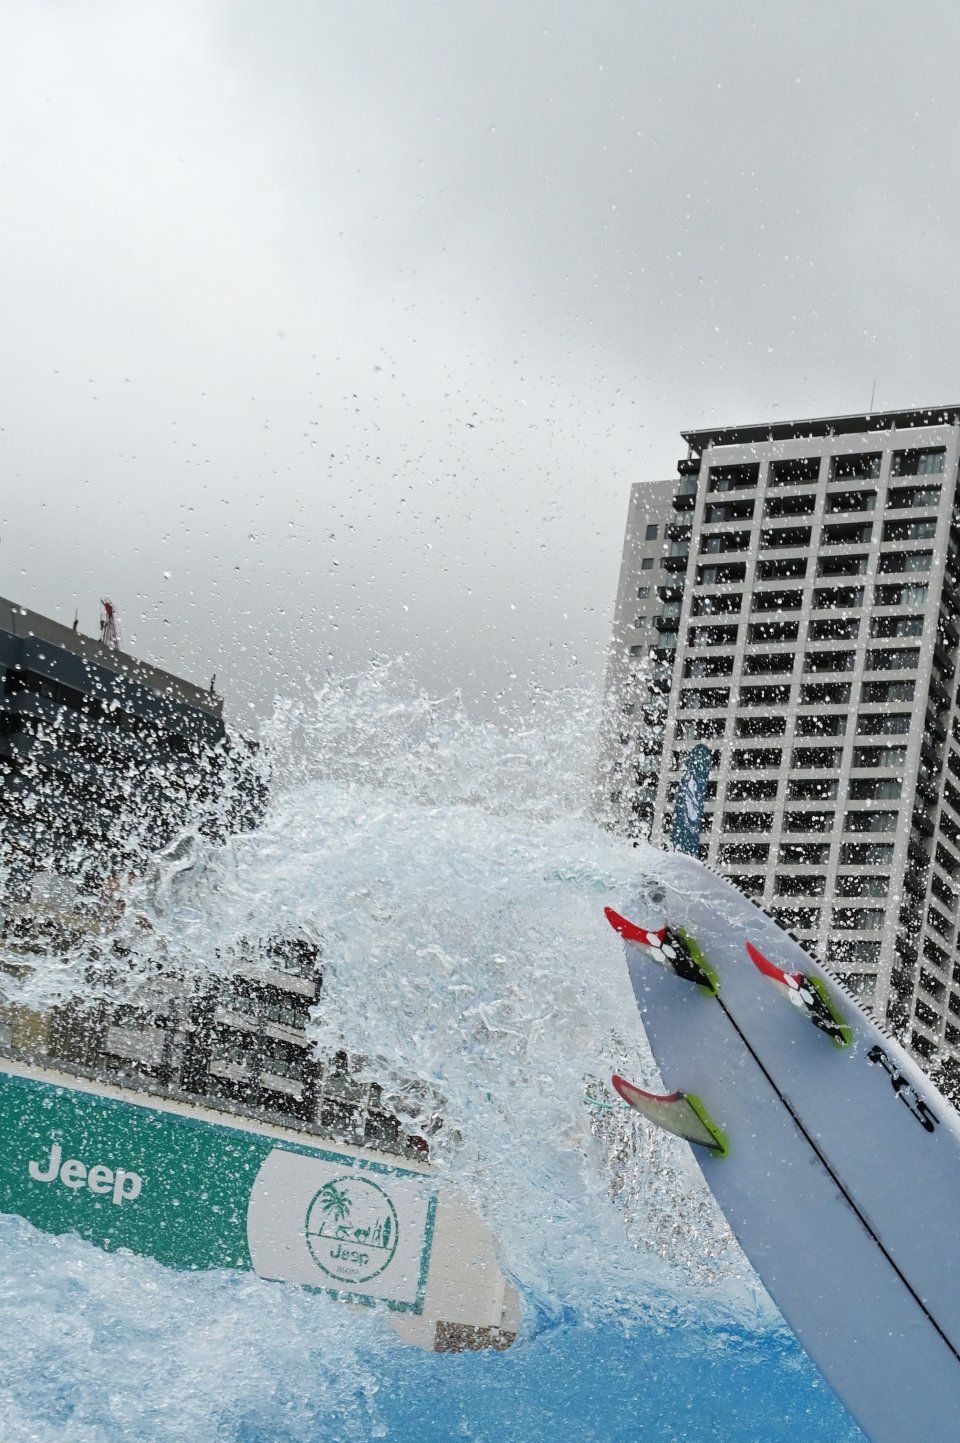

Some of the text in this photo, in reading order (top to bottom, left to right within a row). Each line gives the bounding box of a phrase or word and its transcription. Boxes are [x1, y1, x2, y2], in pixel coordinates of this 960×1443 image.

[867, 1045, 940, 1133] FCS
[28, 1141, 142, 1206] Jeep
[329, 1244, 369, 1267] Jeep
